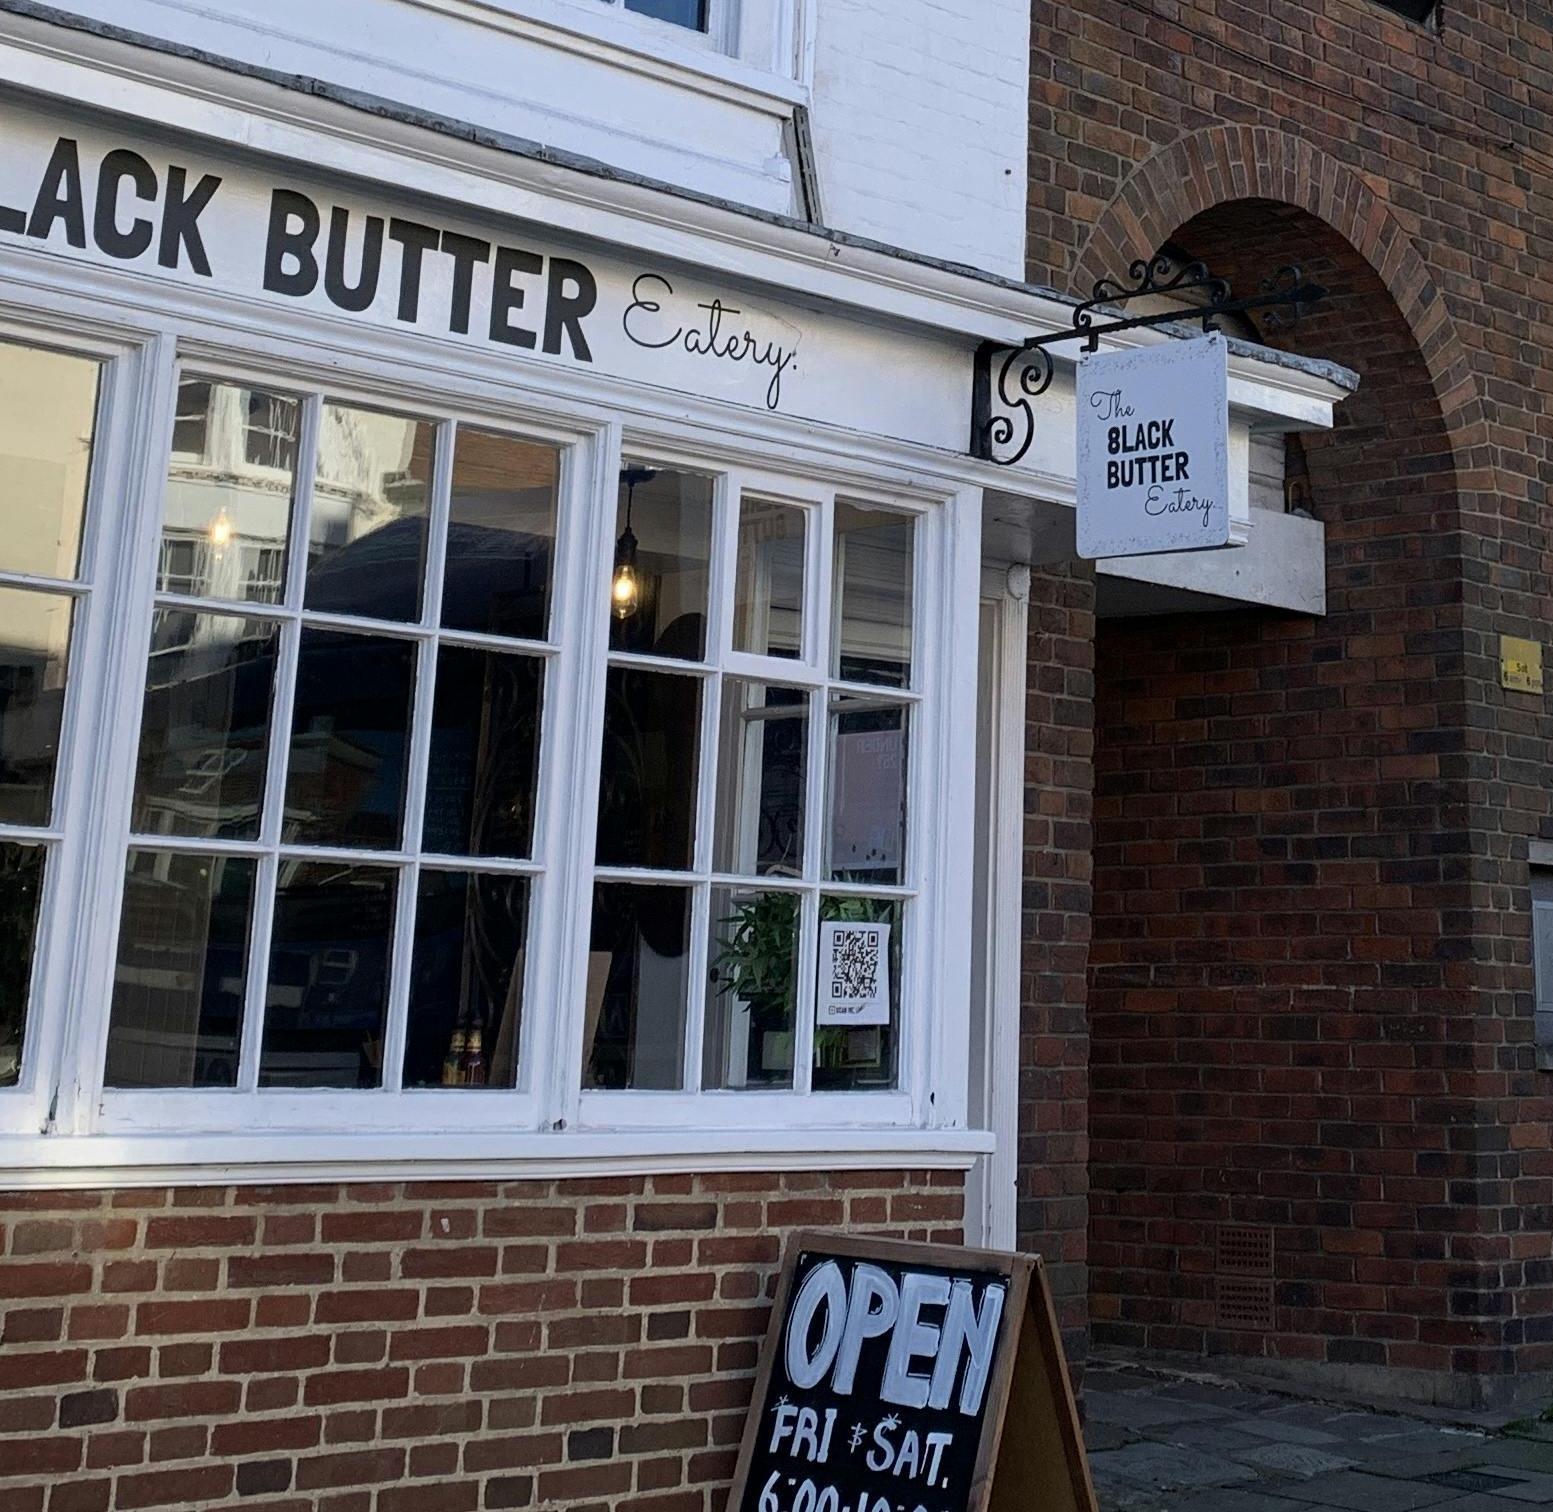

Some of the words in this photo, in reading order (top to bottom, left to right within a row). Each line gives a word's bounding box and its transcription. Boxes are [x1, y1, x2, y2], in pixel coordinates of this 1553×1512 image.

[263, 189, 597, 363] BUTTER
[1090, 389, 1135, 421] The
[1107, 451, 1190, 489] BUTTER
[785, 1259, 1008, 1416] OPEN
[769, 1402, 837, 1463] FRI
